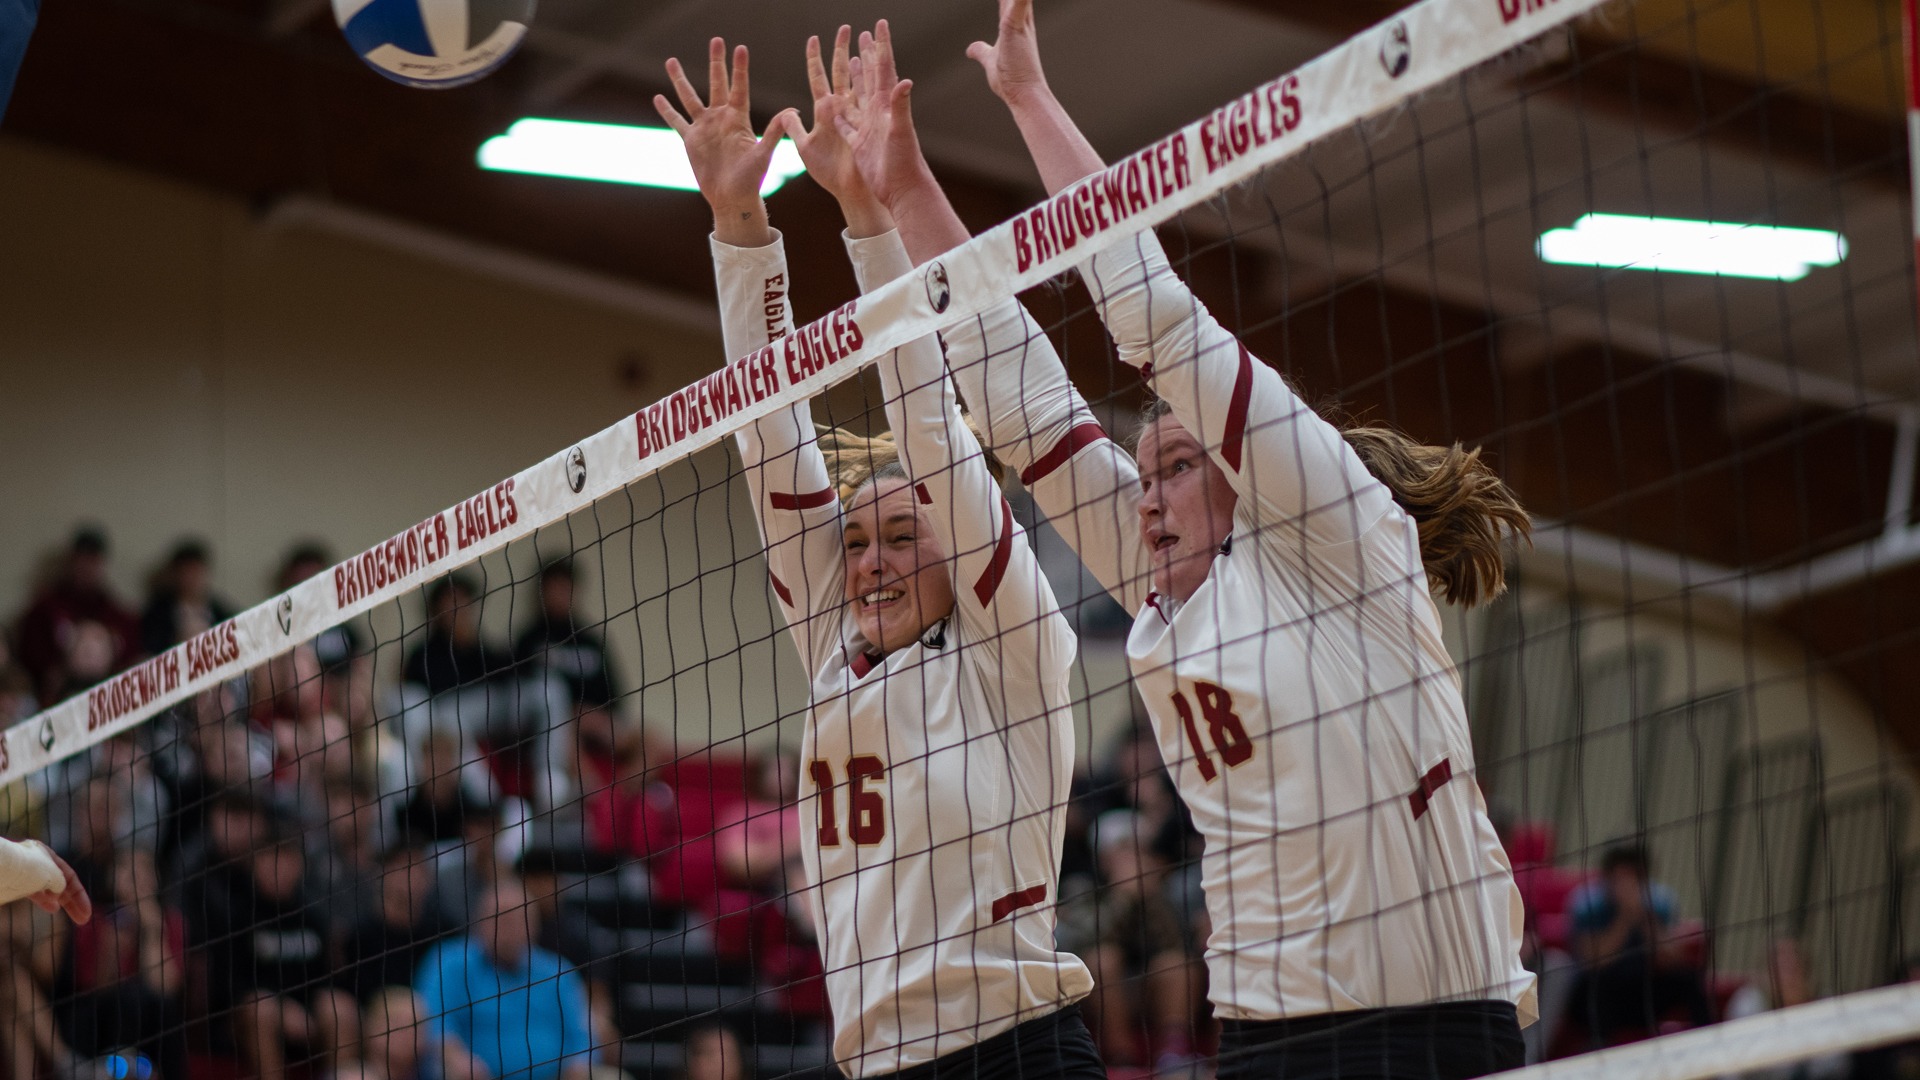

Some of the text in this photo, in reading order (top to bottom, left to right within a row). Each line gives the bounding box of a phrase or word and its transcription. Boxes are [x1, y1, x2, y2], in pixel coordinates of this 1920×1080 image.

[1013, 75, 1302, 274] BRIDGEWATER EAGLES
[764, 273, 786, 344] EAGLE
[635, 300, 864, 460] BRIDGEWATER EAGLES
[335, 477, 518, 609] BRIDGEWATER EAGLES
[88, 618, 240, 732] BRIDGEWATER EAGLES
[1168, 679, 1255, 784] 18
[807, 752, 887, 849] 16
